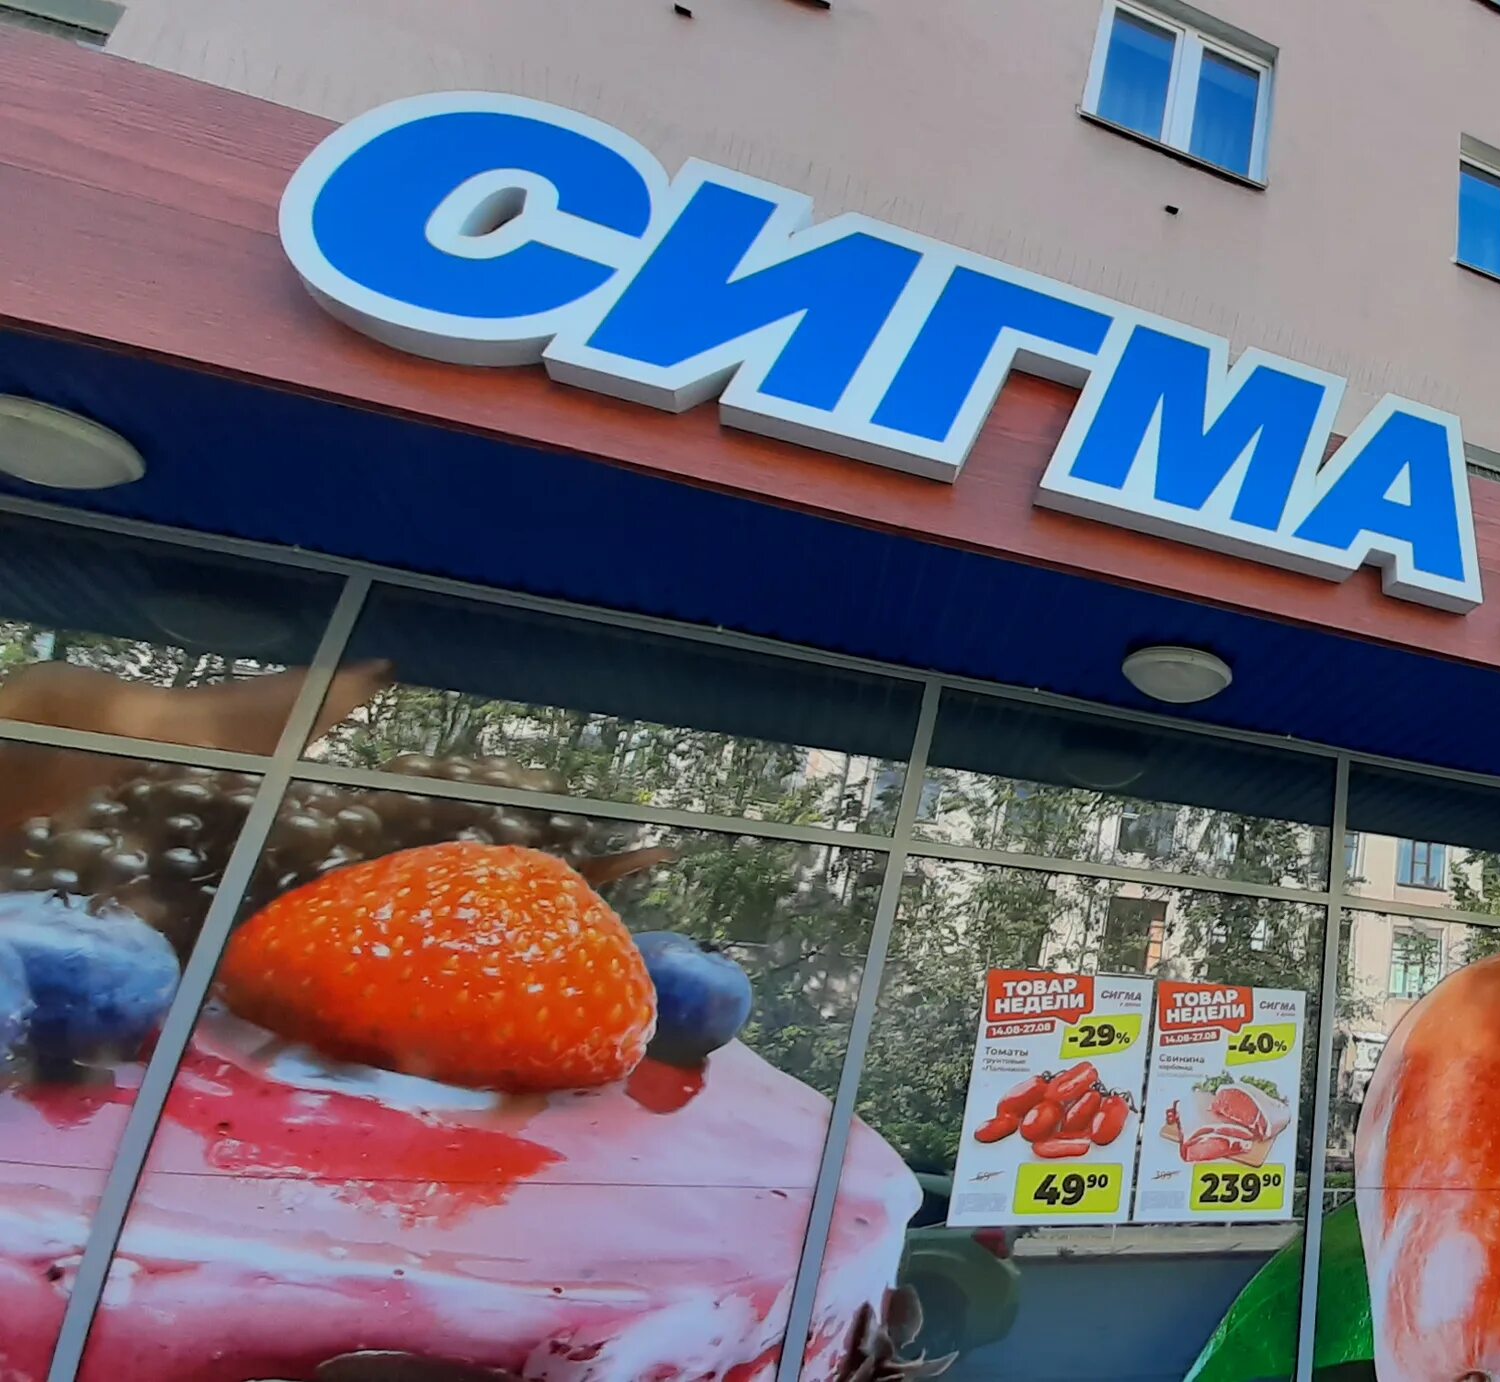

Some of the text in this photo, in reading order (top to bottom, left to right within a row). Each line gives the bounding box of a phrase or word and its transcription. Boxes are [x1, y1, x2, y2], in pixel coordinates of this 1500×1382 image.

[282, 94, 1480, 610] СИГМА
[1002, 978, 1078, 997] ТОВАР
[1101, 989, 1142, 1001] СИГМА
[994, 993, 1086, 1015] НЕДЕЛИ
[1172, 989, 1239, 1007] ТОВАР
[1259, 1000, 1297, 1011] СИГМА
[1166, 1003, 1246, 1024] НЕДЕЛИ
[991, 1022, 1052, 1036] 14.08-27.08
[1068, 1023, 1131, 1048] -29%
[1164, 1032, 1218, 1045] 14.08-27.08
[1228, 1032, 1288, 1055] -40%
[985, 1046, 1029, 1057] Томаты
[1159, 1053, 1206, 1064] Свинина
